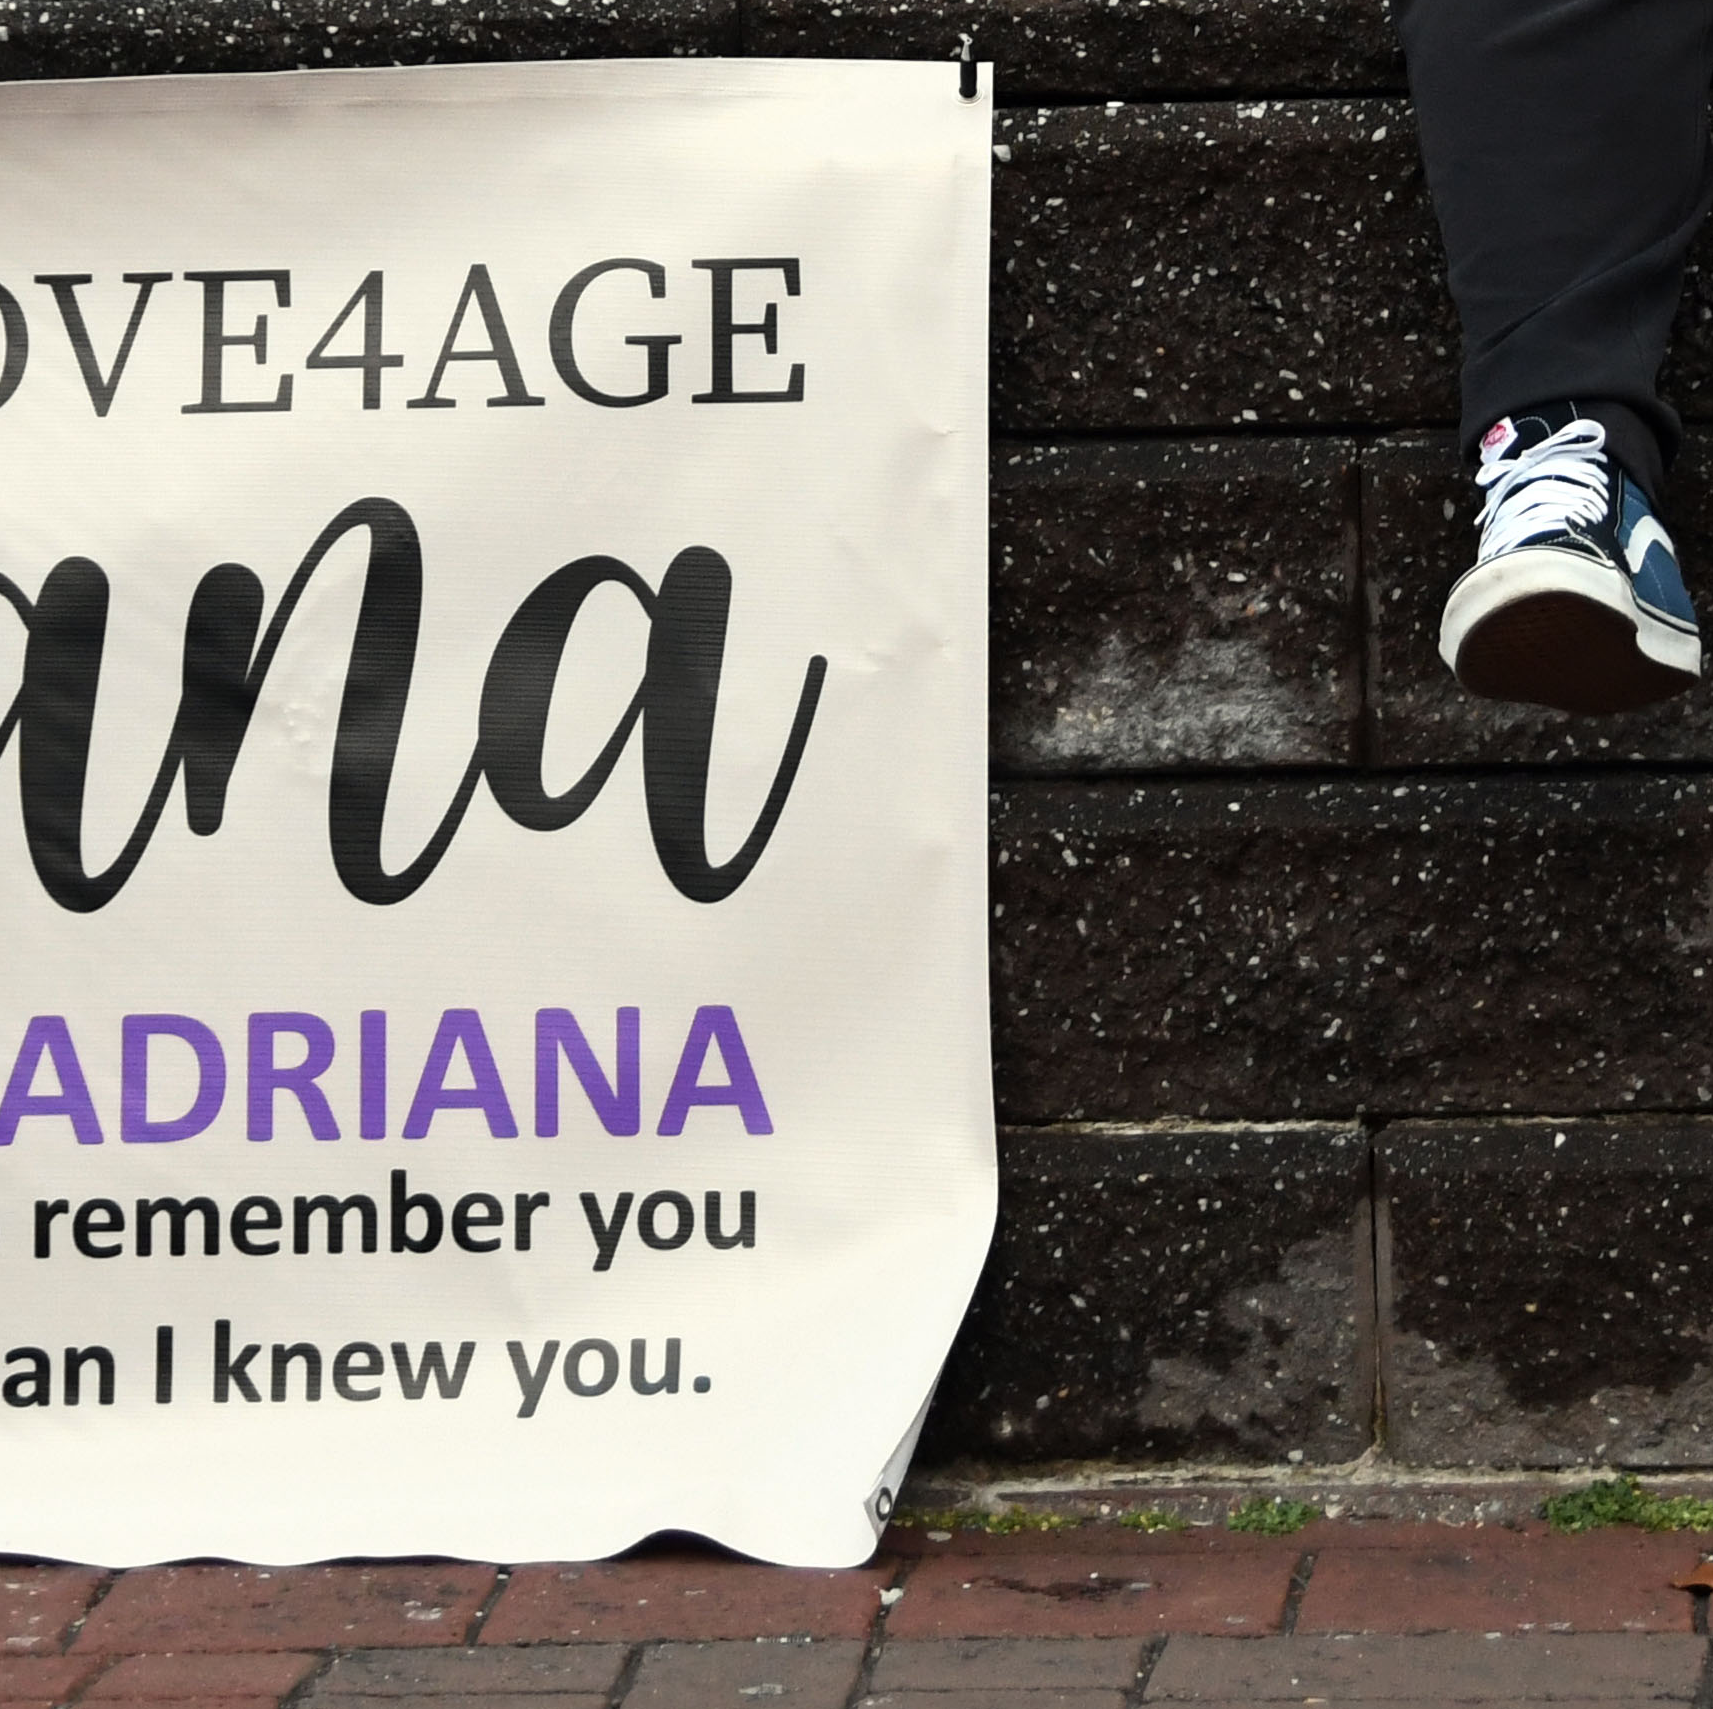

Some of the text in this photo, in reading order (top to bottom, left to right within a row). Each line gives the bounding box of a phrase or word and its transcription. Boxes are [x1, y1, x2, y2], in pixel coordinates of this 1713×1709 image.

[34, 1168, 550, 1259] remember
[579, 1190, 756, 1272] you
[155, 1325, 174, 1404] I
[213, 1319, 476, 1403] knew
[506, 1338, 711, 1418] you.
